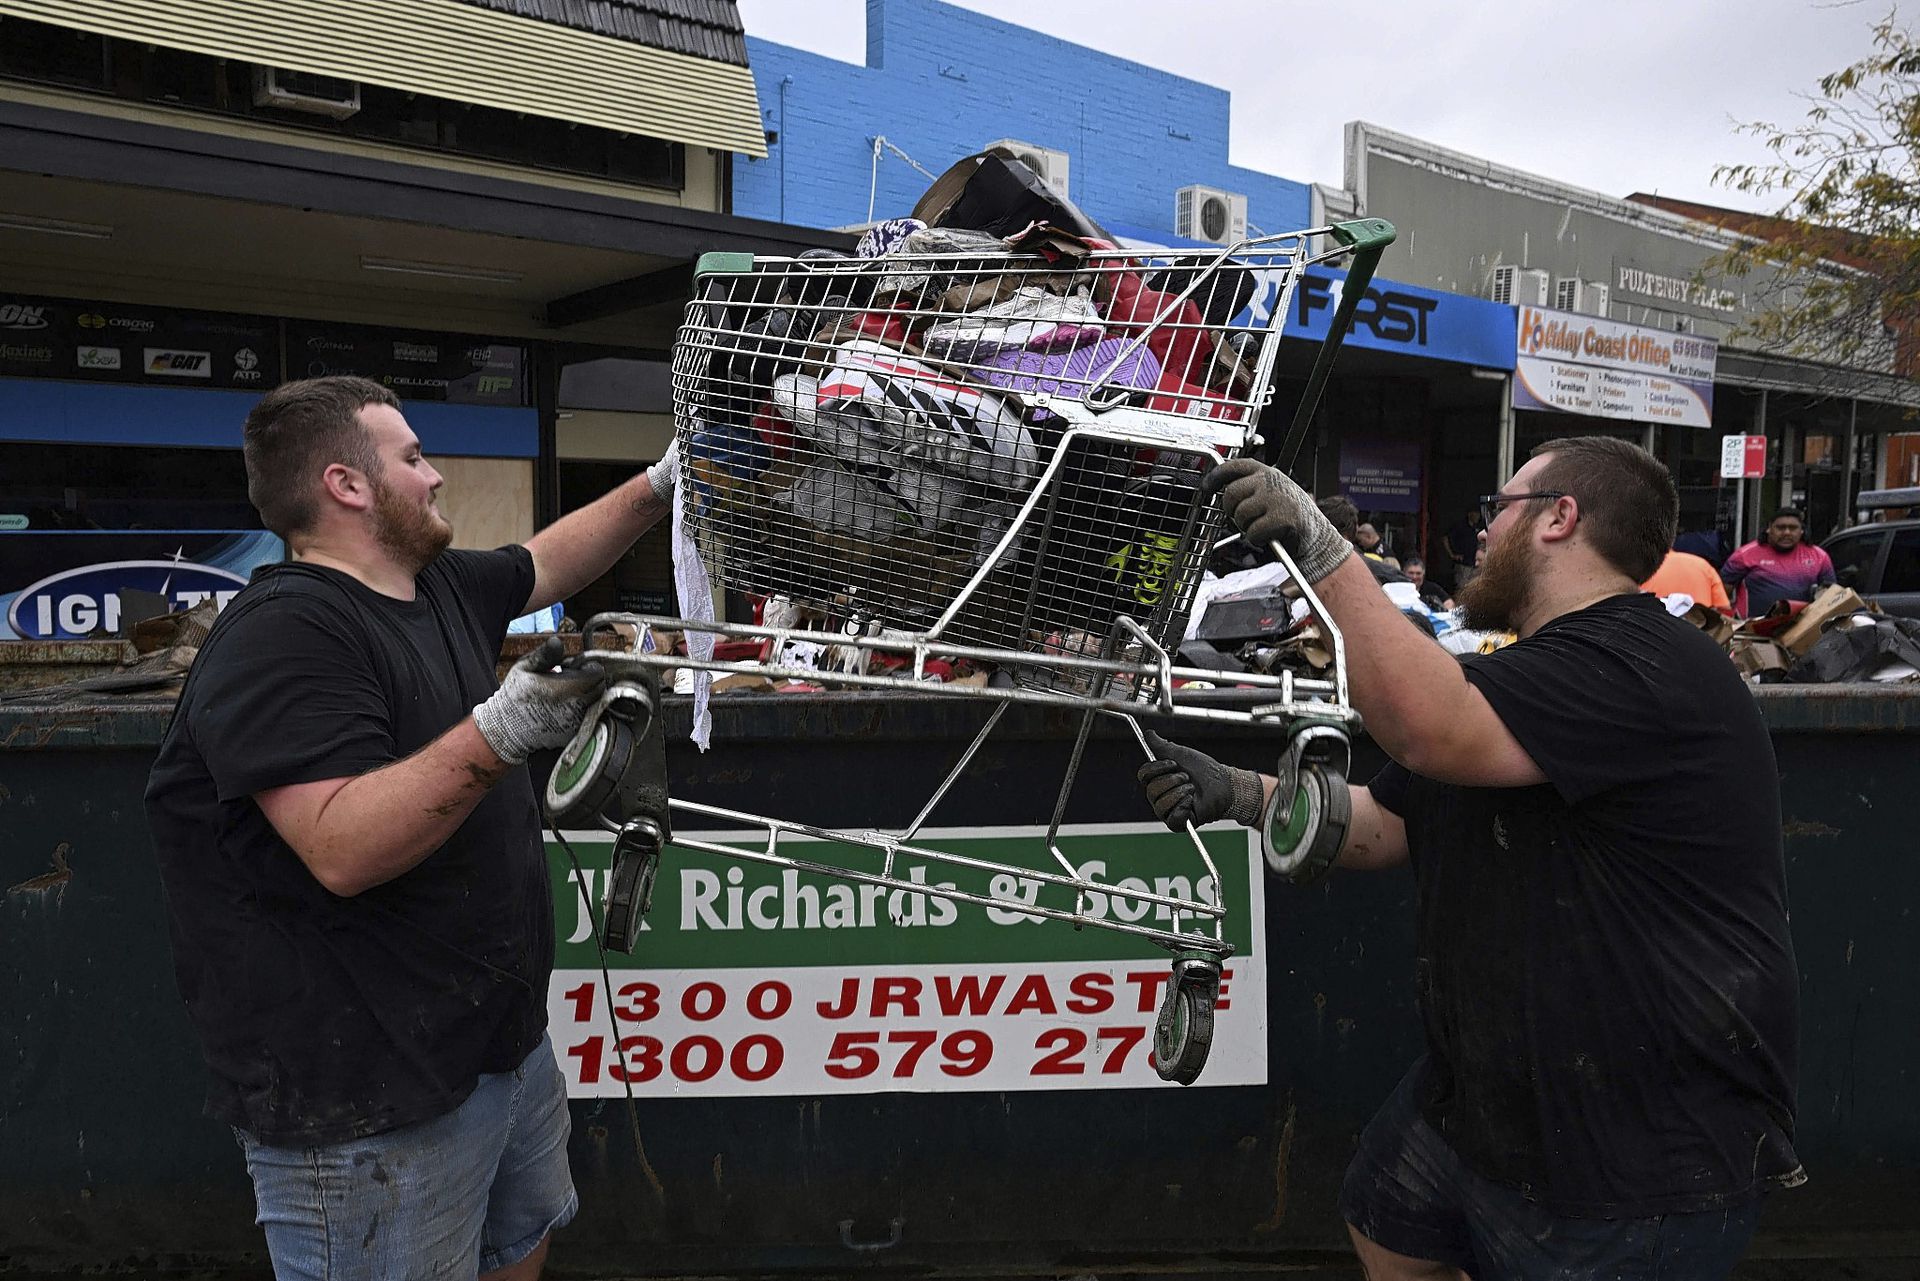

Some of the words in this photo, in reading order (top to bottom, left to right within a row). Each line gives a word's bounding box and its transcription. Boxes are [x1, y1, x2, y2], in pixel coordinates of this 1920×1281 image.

[1519, 308, 1583, 359] Holiday
[1584, 325, 1627, 360] Coast
[1628, 334, 1670, 368] Office
[233, 370, 261, 381] ATP
[1557, 366, 1589, 382] Stationery
[1603, 373, 1641, 387] Photocopiers
[393, 376, 449, 388] CELLUCOR
[1556, 380, 1586, 393] Furniture
[1603, 386, 1626, 398] Printers
[1556, 395, 1566, 405] Ink
[1602, 400, 1633, 412] Computers
[1726, 438, 1742, 448] 2P
[679, 864, 958, 932] Richards
[986, 872, 1047, 926] &
[1079, 860, 1219, 922] Sons
[564, 980, 793, 1022] 1300
[567, 1033, 786, 1083] 1300
[824, 1029, 994, 1080] 579
[1030, 1026, 1159, 1076] 27
